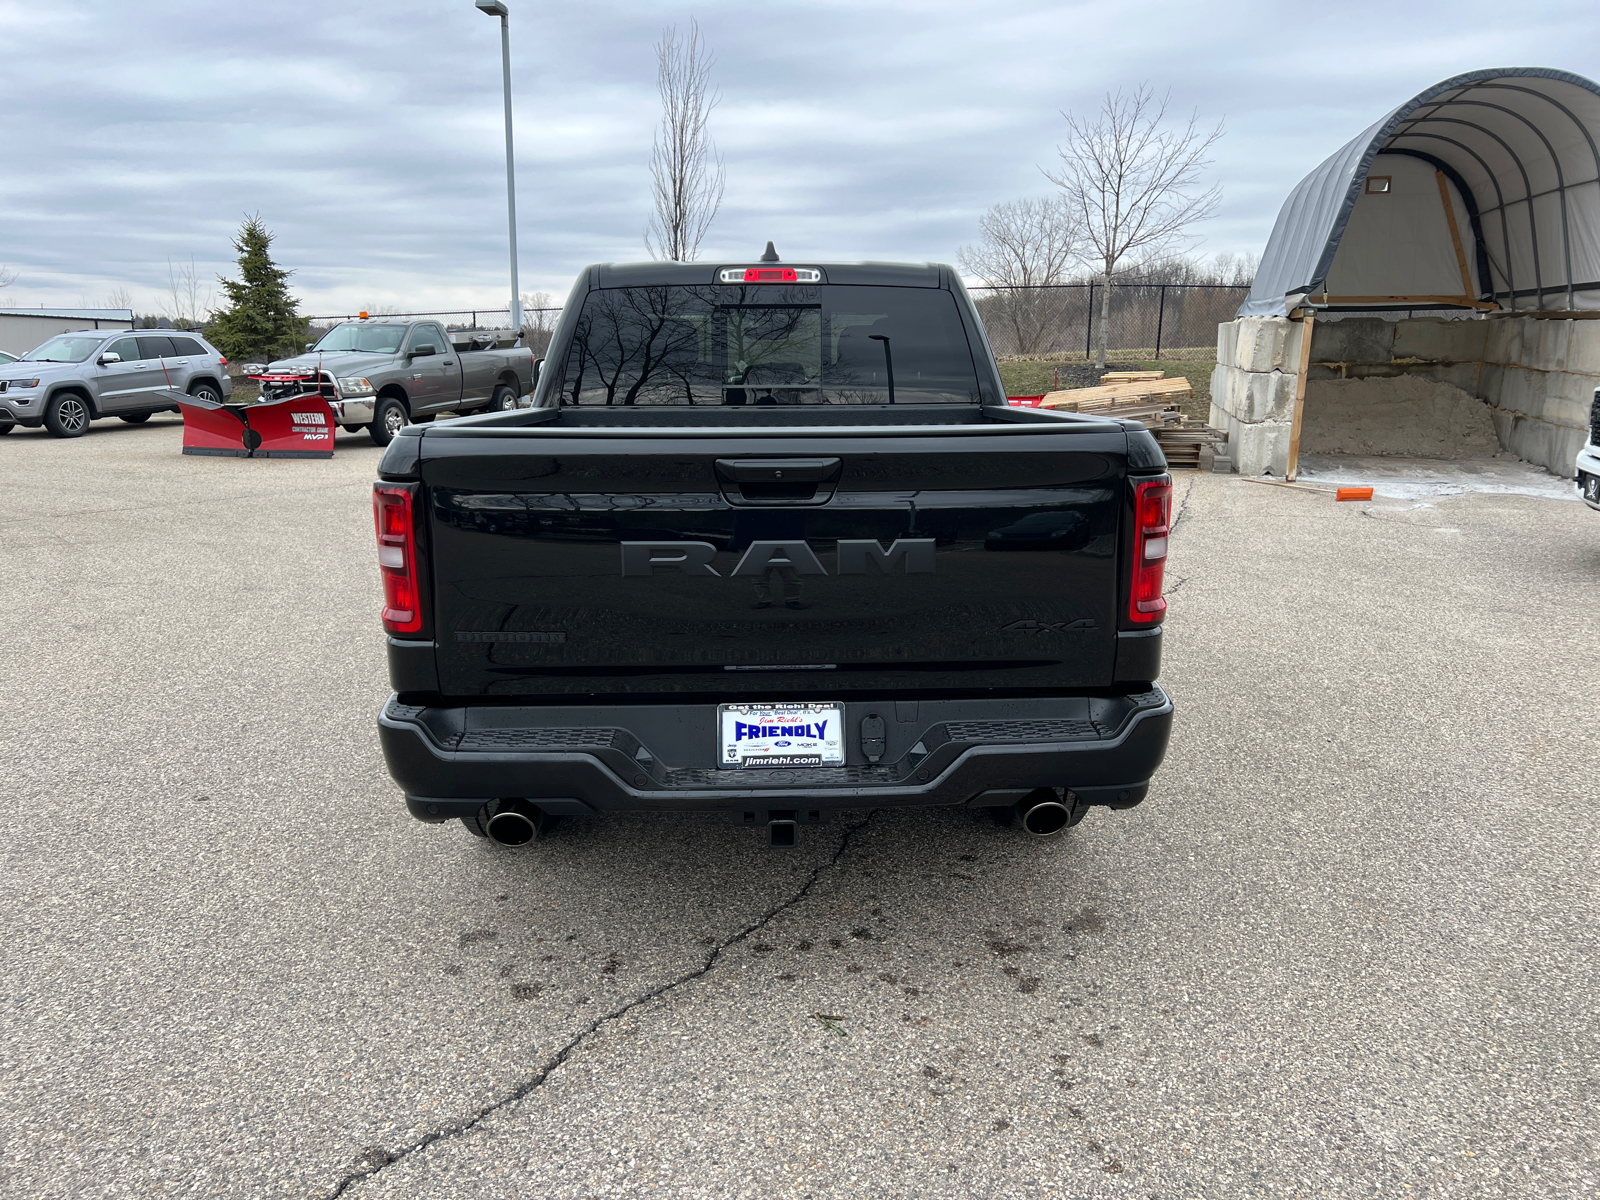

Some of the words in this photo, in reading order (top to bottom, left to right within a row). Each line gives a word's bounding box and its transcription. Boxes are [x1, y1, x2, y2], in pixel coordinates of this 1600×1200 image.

[291, 412, 326, 424] WESTERN
[620, 538, 936, 578] RAM
[758, 716, 775, 725] Jim
[735, 719, 828, 742] FRIENDLY
[745, 756, 819, 766] jimriehl.com
